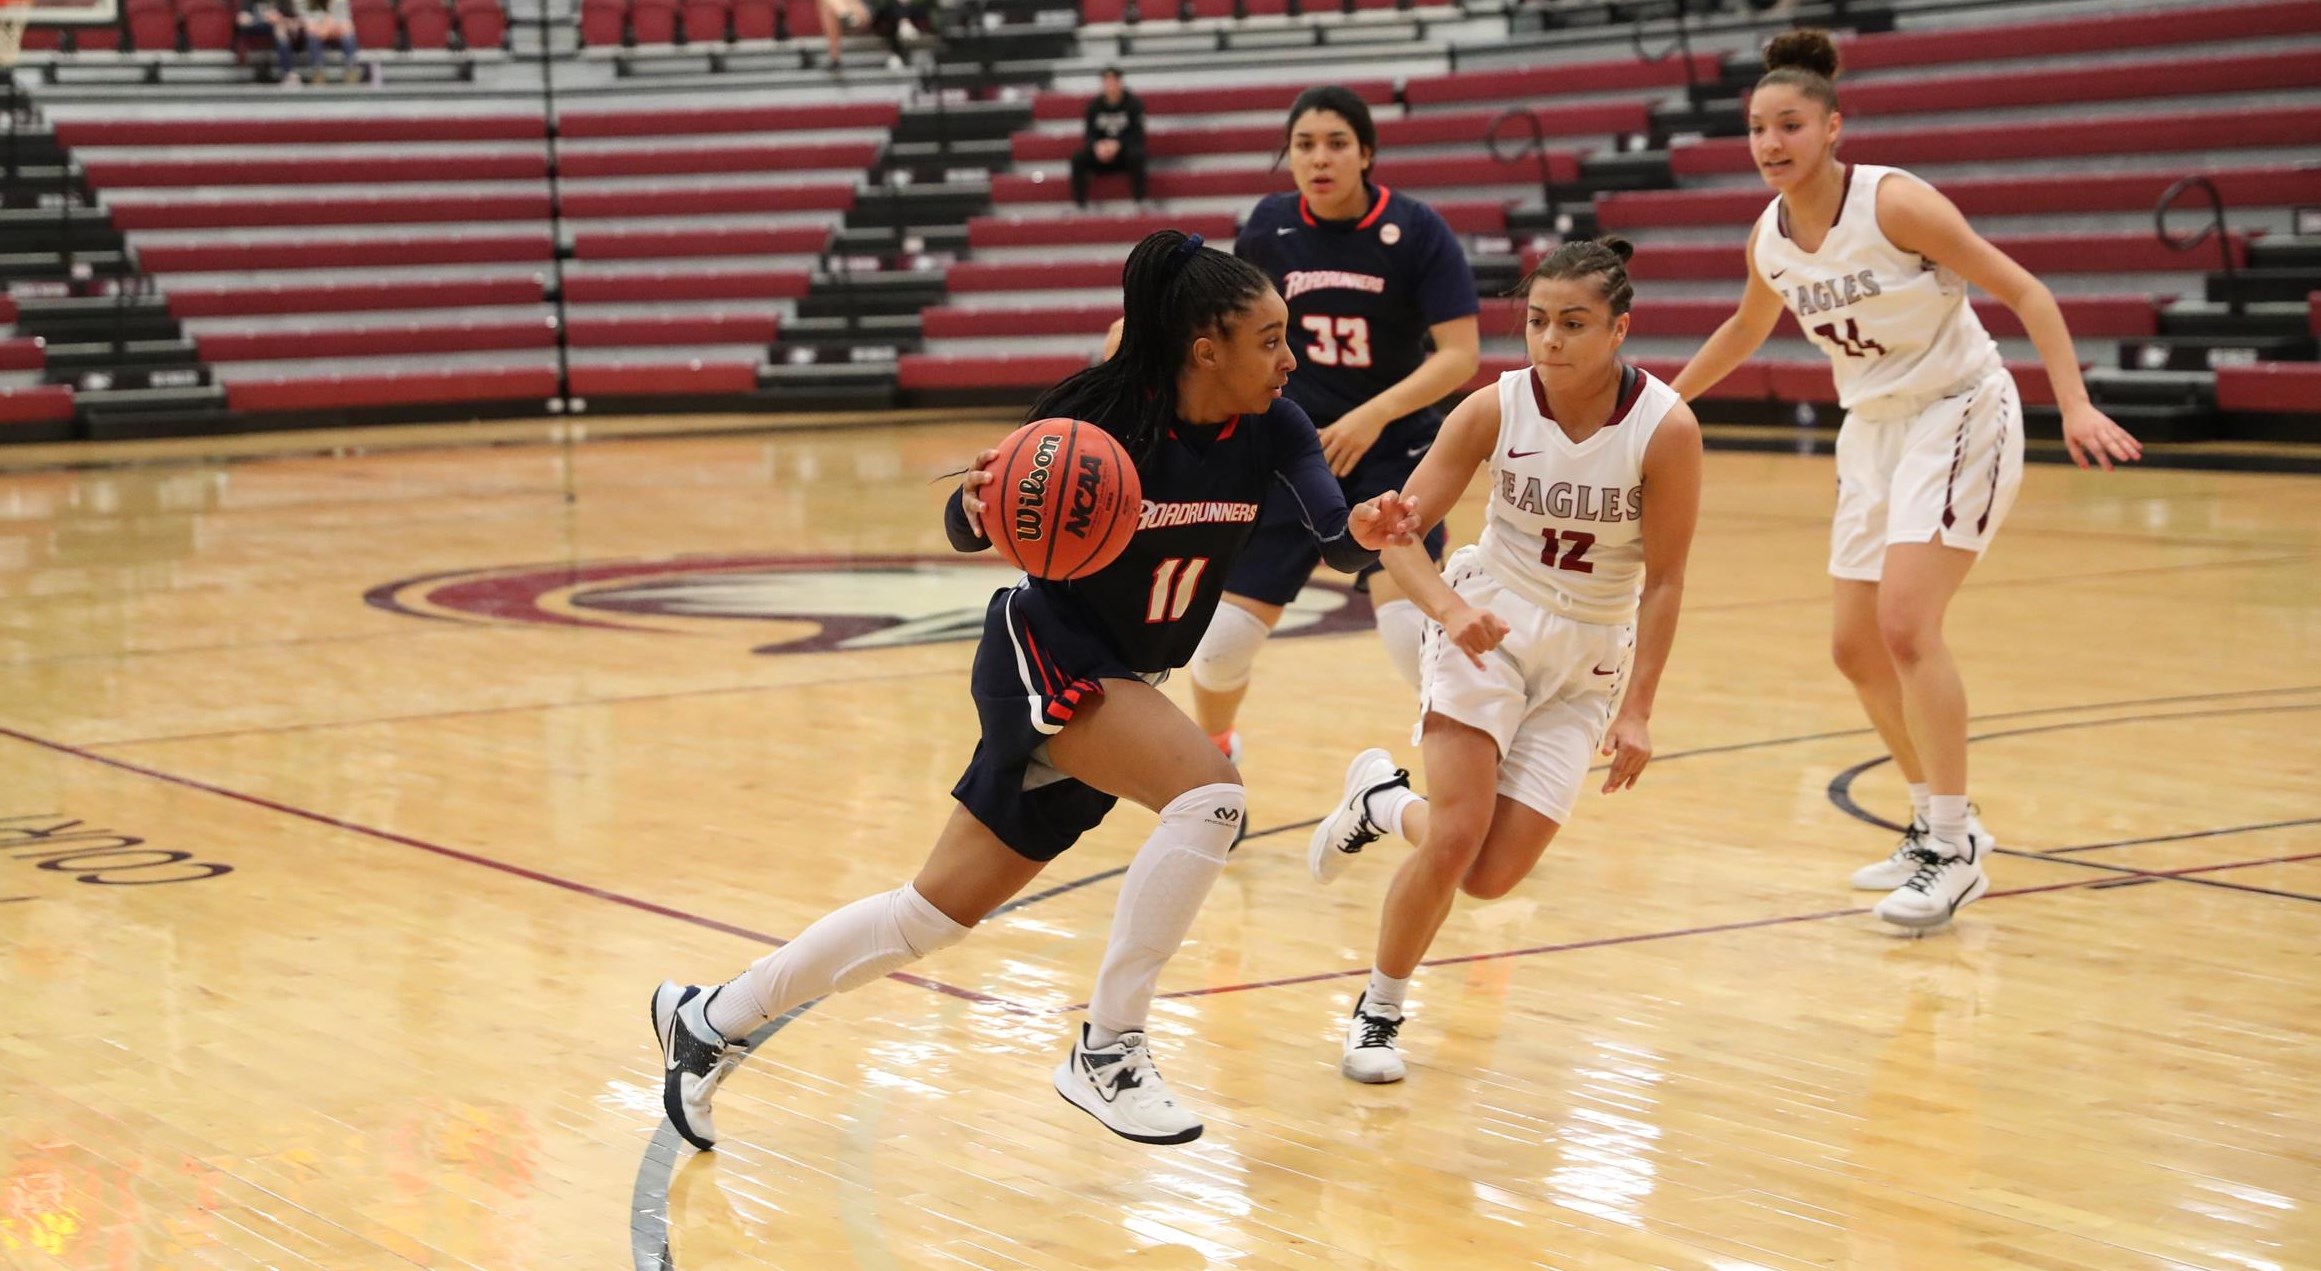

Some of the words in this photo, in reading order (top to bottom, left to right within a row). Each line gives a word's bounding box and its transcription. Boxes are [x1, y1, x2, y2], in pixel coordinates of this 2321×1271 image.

[1284, 270, 1386, 301] ROADRUNNERS
[1782, 269, 1882, 316] AGLES
[1302, 315, 1371, 367] 33
[1016, 434, 1063, 542] Wilson
[1064, 454, 1102, 539] NCAA
[1501, 469, 1642, 522] EAGLES
[1137, 499, 1258, 531] ROADRUNNERS
[1540, 527, 1595, 574] 12
[1145, 557, 1210, 623] 11
